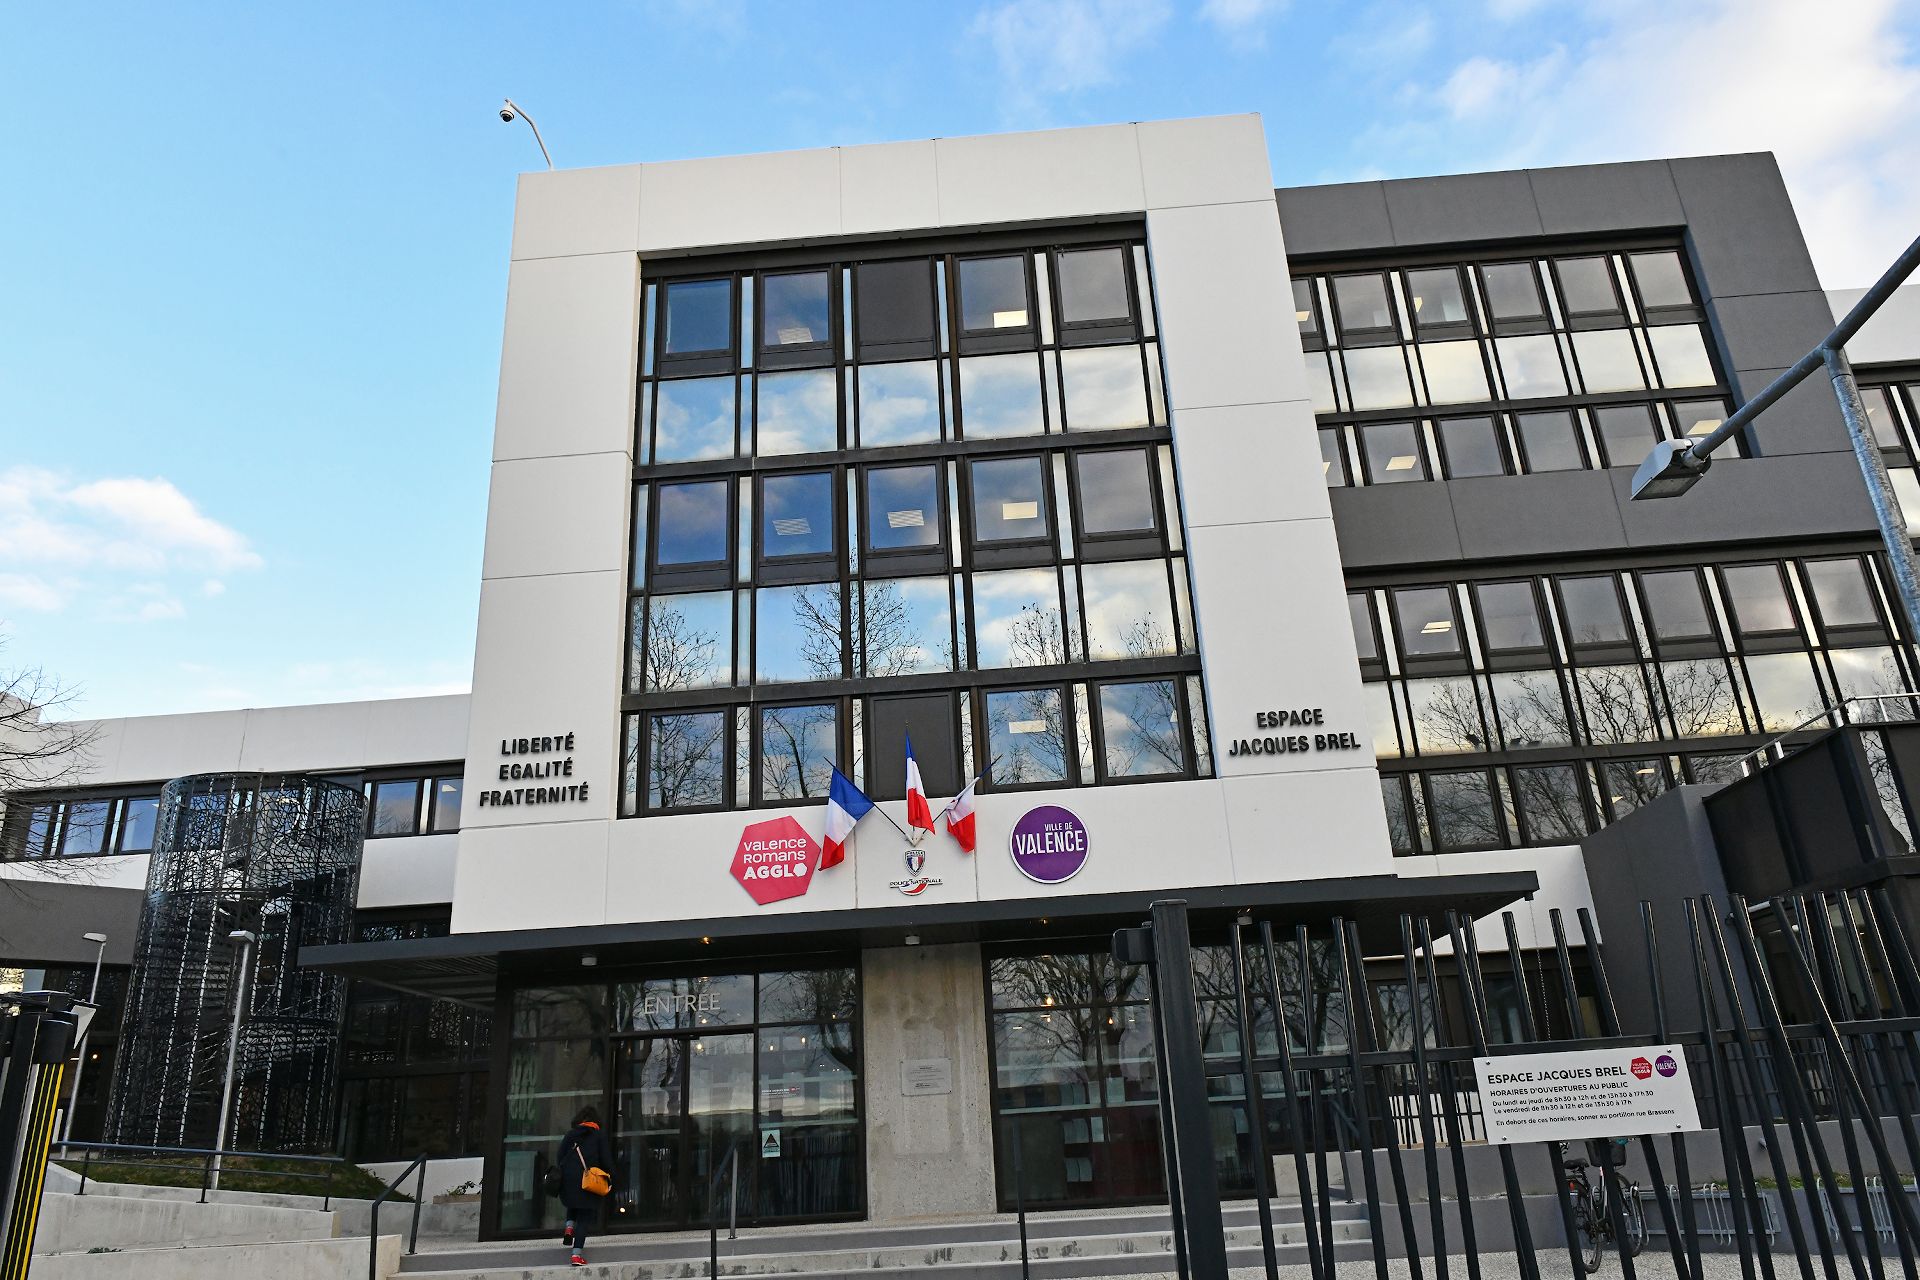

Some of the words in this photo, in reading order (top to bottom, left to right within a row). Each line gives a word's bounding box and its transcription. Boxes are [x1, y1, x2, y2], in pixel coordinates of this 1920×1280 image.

[1256, 708, 1324, 728] ESPACE
[501, 732, 574, 755] LIBERTÉ
[1229, 735, 1310, 756] JACQUES
[1314, 732, 1361, 751] BREL
[499, 757, 573, 780] EGALITÉ
[479, 781, 589, 807] FRATERNITÉ
[1044, 823, 1063, 831] VILLE
[1064, 822, 1073, 830] DE
[1016, 830, 1084, 855] VALENCE
[743, 863, 807, 880] AGGLO
[1488, 1072, 1534, 1084] ESPACE
[1537, 1069, 1592, 1081] JACQUES
[1595, 1066, 1627, 1077] BREL
[1530, 1085, 1587, 1094] D'OUVERTURES
